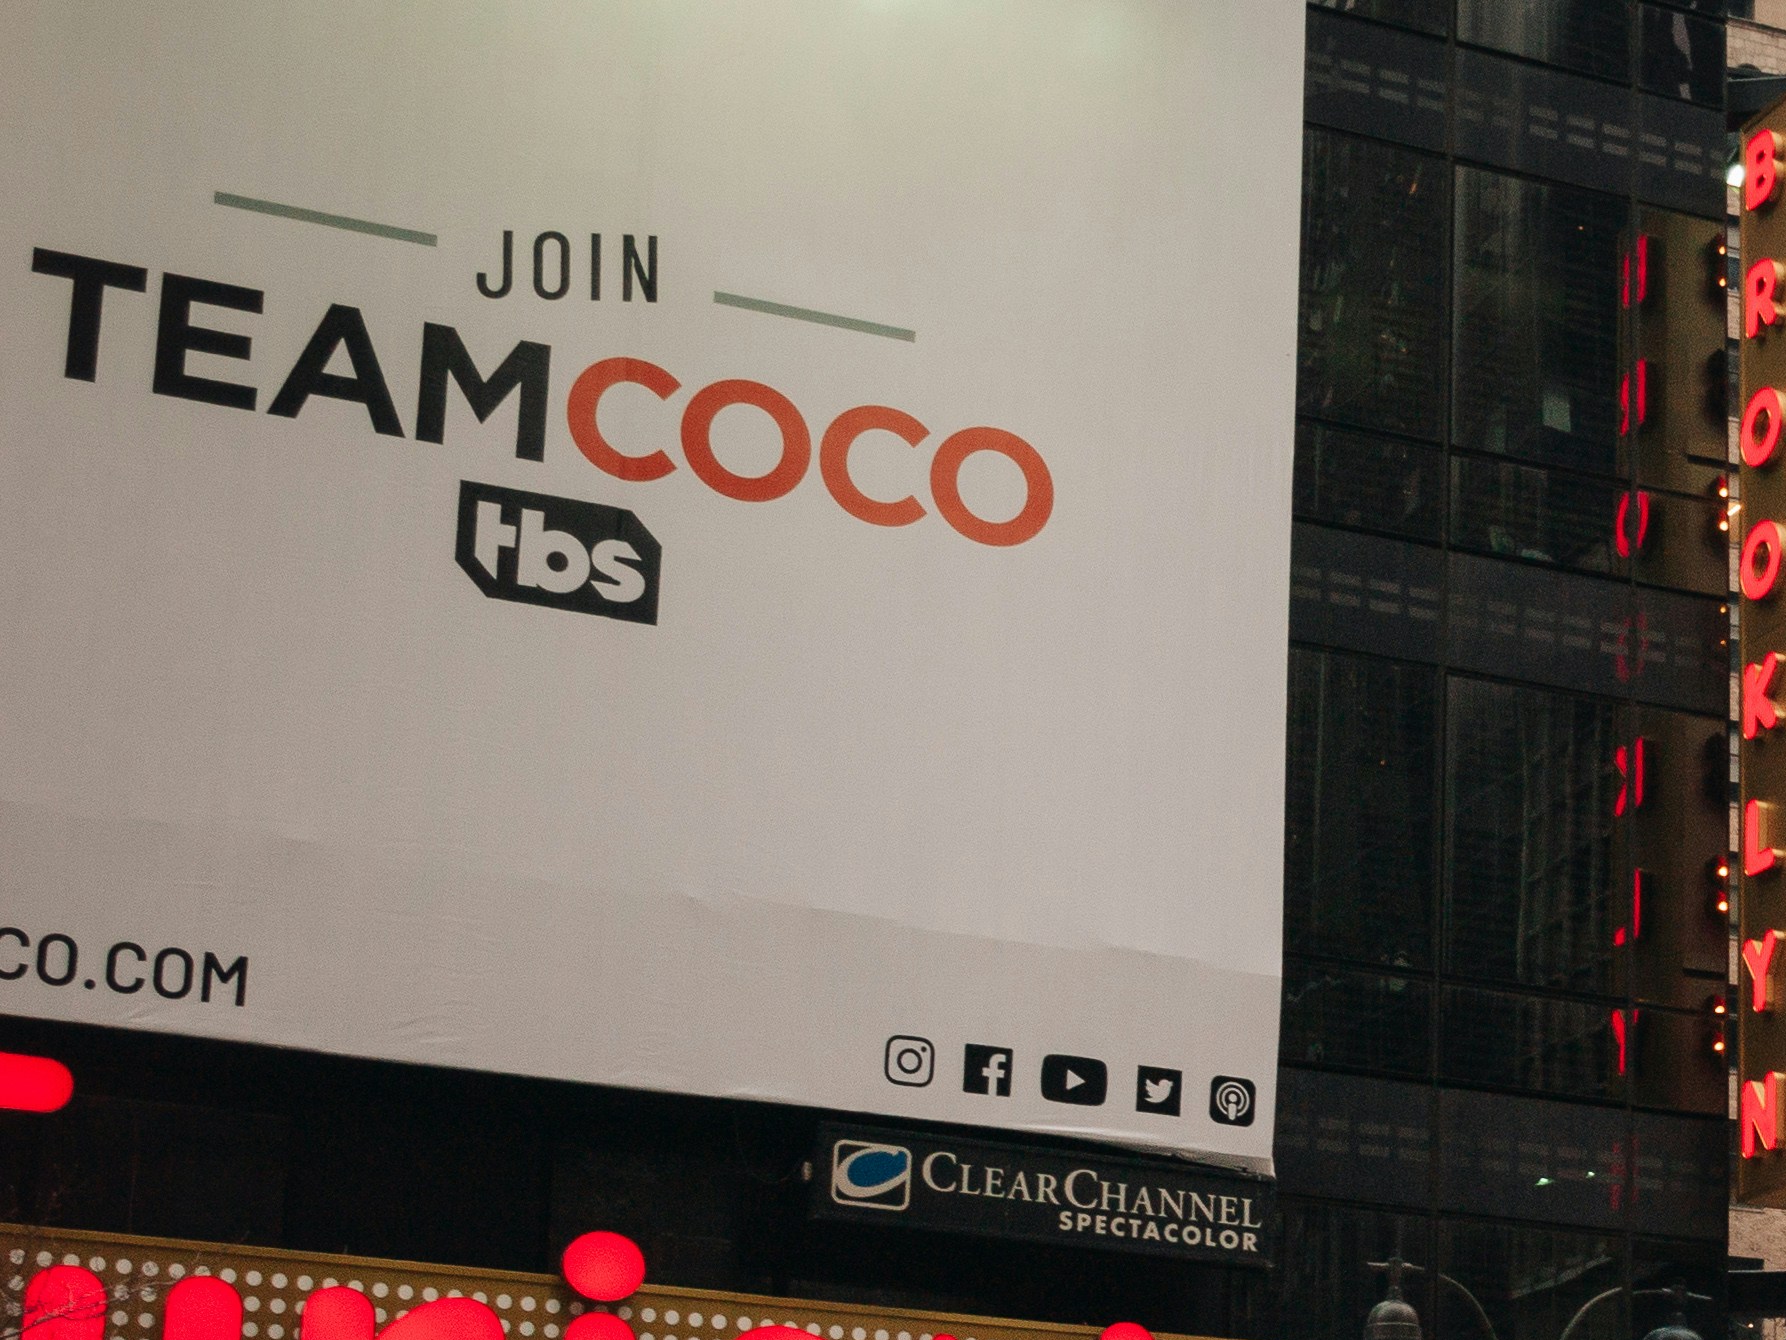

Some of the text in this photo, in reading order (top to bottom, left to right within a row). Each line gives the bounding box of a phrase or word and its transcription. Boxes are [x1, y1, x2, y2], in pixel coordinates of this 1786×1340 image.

[476, 229, 659, 303] JOIN
[31, 247, 1055, 547] TEAMCOCO
[474, 500, 646, 603] tbs
[1739, 128, 1786, 1159] BROOKLYN
[0, 927, 248, 1007] CO.COM
[1059, 1211, 1258, 1252] SPECTACOLOR
